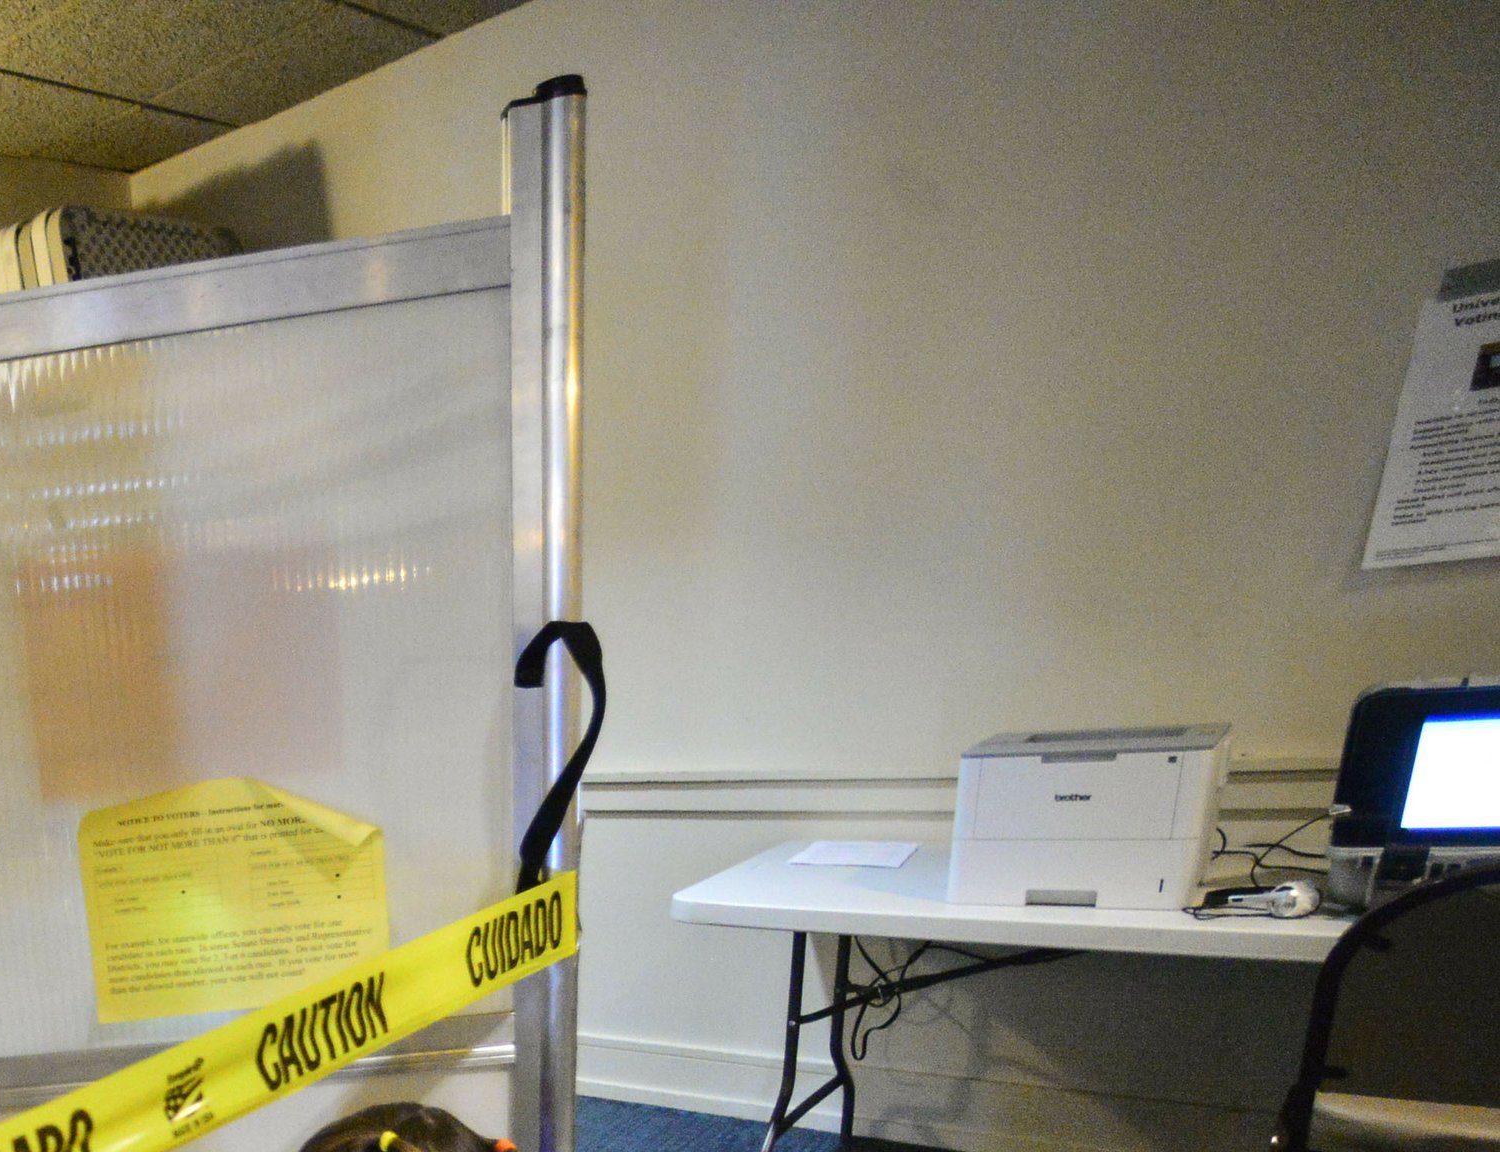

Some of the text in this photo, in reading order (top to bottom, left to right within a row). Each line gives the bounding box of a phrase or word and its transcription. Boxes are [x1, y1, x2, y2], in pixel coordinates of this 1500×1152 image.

[1455, 311, 1500, 327] Votin
[1053, 792, 1092, 801] brother
[467, 891, 562, 986] CUIDADO
[256, 973, 388, 1091] CAUTION
